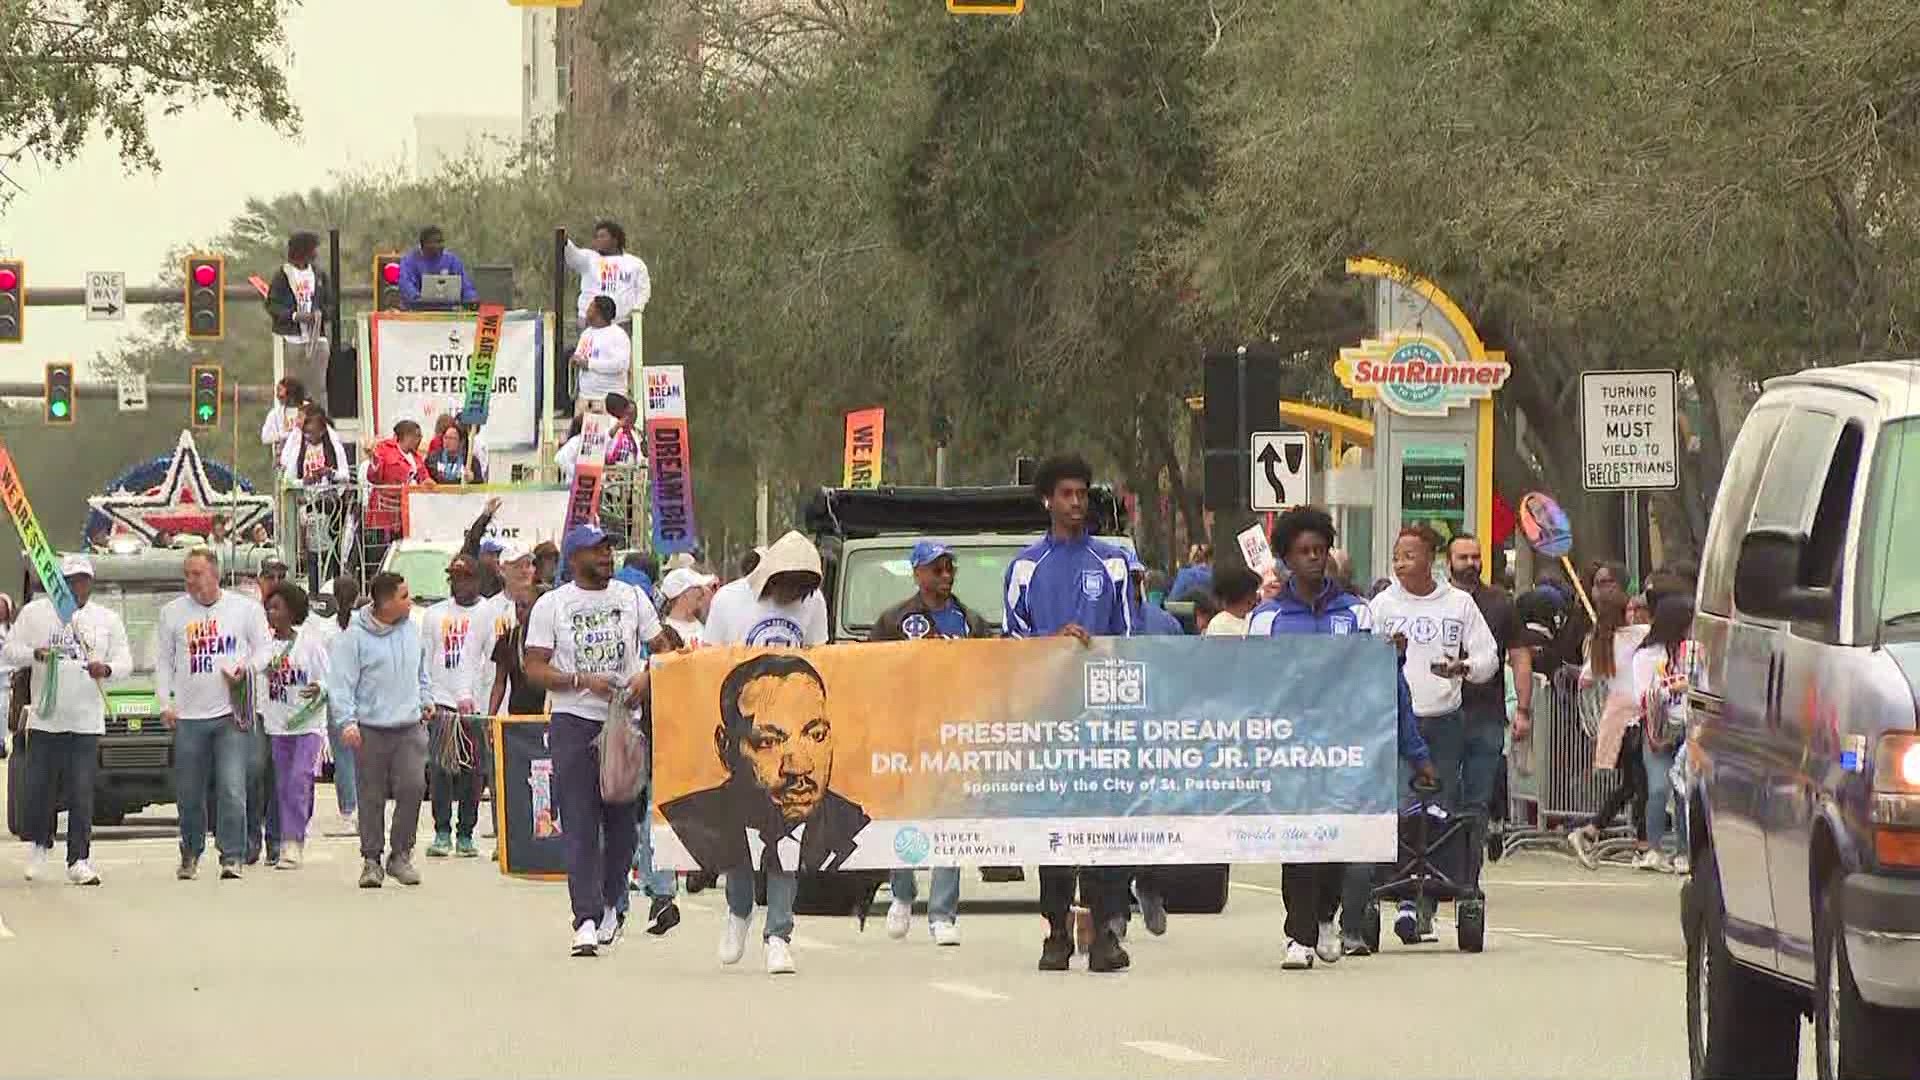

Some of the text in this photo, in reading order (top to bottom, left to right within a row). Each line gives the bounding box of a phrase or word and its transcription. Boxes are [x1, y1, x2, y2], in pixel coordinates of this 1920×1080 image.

[92, 275, 120, 287] ONE
[93, 288, 119, 300] WAY
[482, 315, 499, 336] WE
[479, 337, 495, 360] ARE
[430, 354, 463, 372] CITY
[1355, 360, 1505, 385] SunRunner
[396, 376, 419, 393] ST.
[649, 385, 680, 398] DREAM
[1601, 386, 1656, 398] TURNING
[1602, 404, 1655, 416] TRAFFIC
[1606, 422, 1653, 438] MUST
[852, 425, 873, 456] WE
[1602, 443, 1660, 456] YIELD TO
[1588, 462, 1673, 474] PEDESTRIANS
[189, 635, 236, 655] DREAM
[190, 656, 213, 674] BIG
[1090, 668, 1140, 681] DREAM
[1090, 680, 1140, 704] BIG
[940, 718, 1293, 745] PRESENTS: THE DREAM BIG
[871, 745, 1365, 774] DR. MARTIN LUTHER KING JR. PARADE
[1050, 778, 1067, 795] by
[1073, 778, 1098, 792] the
[1103, 777, 1134, 794] City
[1140, 776, 1155, 792] of
[1159, 777, 1180, 792] St.
[1185, 776, 1272, 793] Petersburg
[1067, 832, 1084, 844] THE
[1087, 832, 1115, 843] FLYNN
[1118, 832, 1138, 843] LAW
[934, 845, 1016, 855] CLEARWATER
